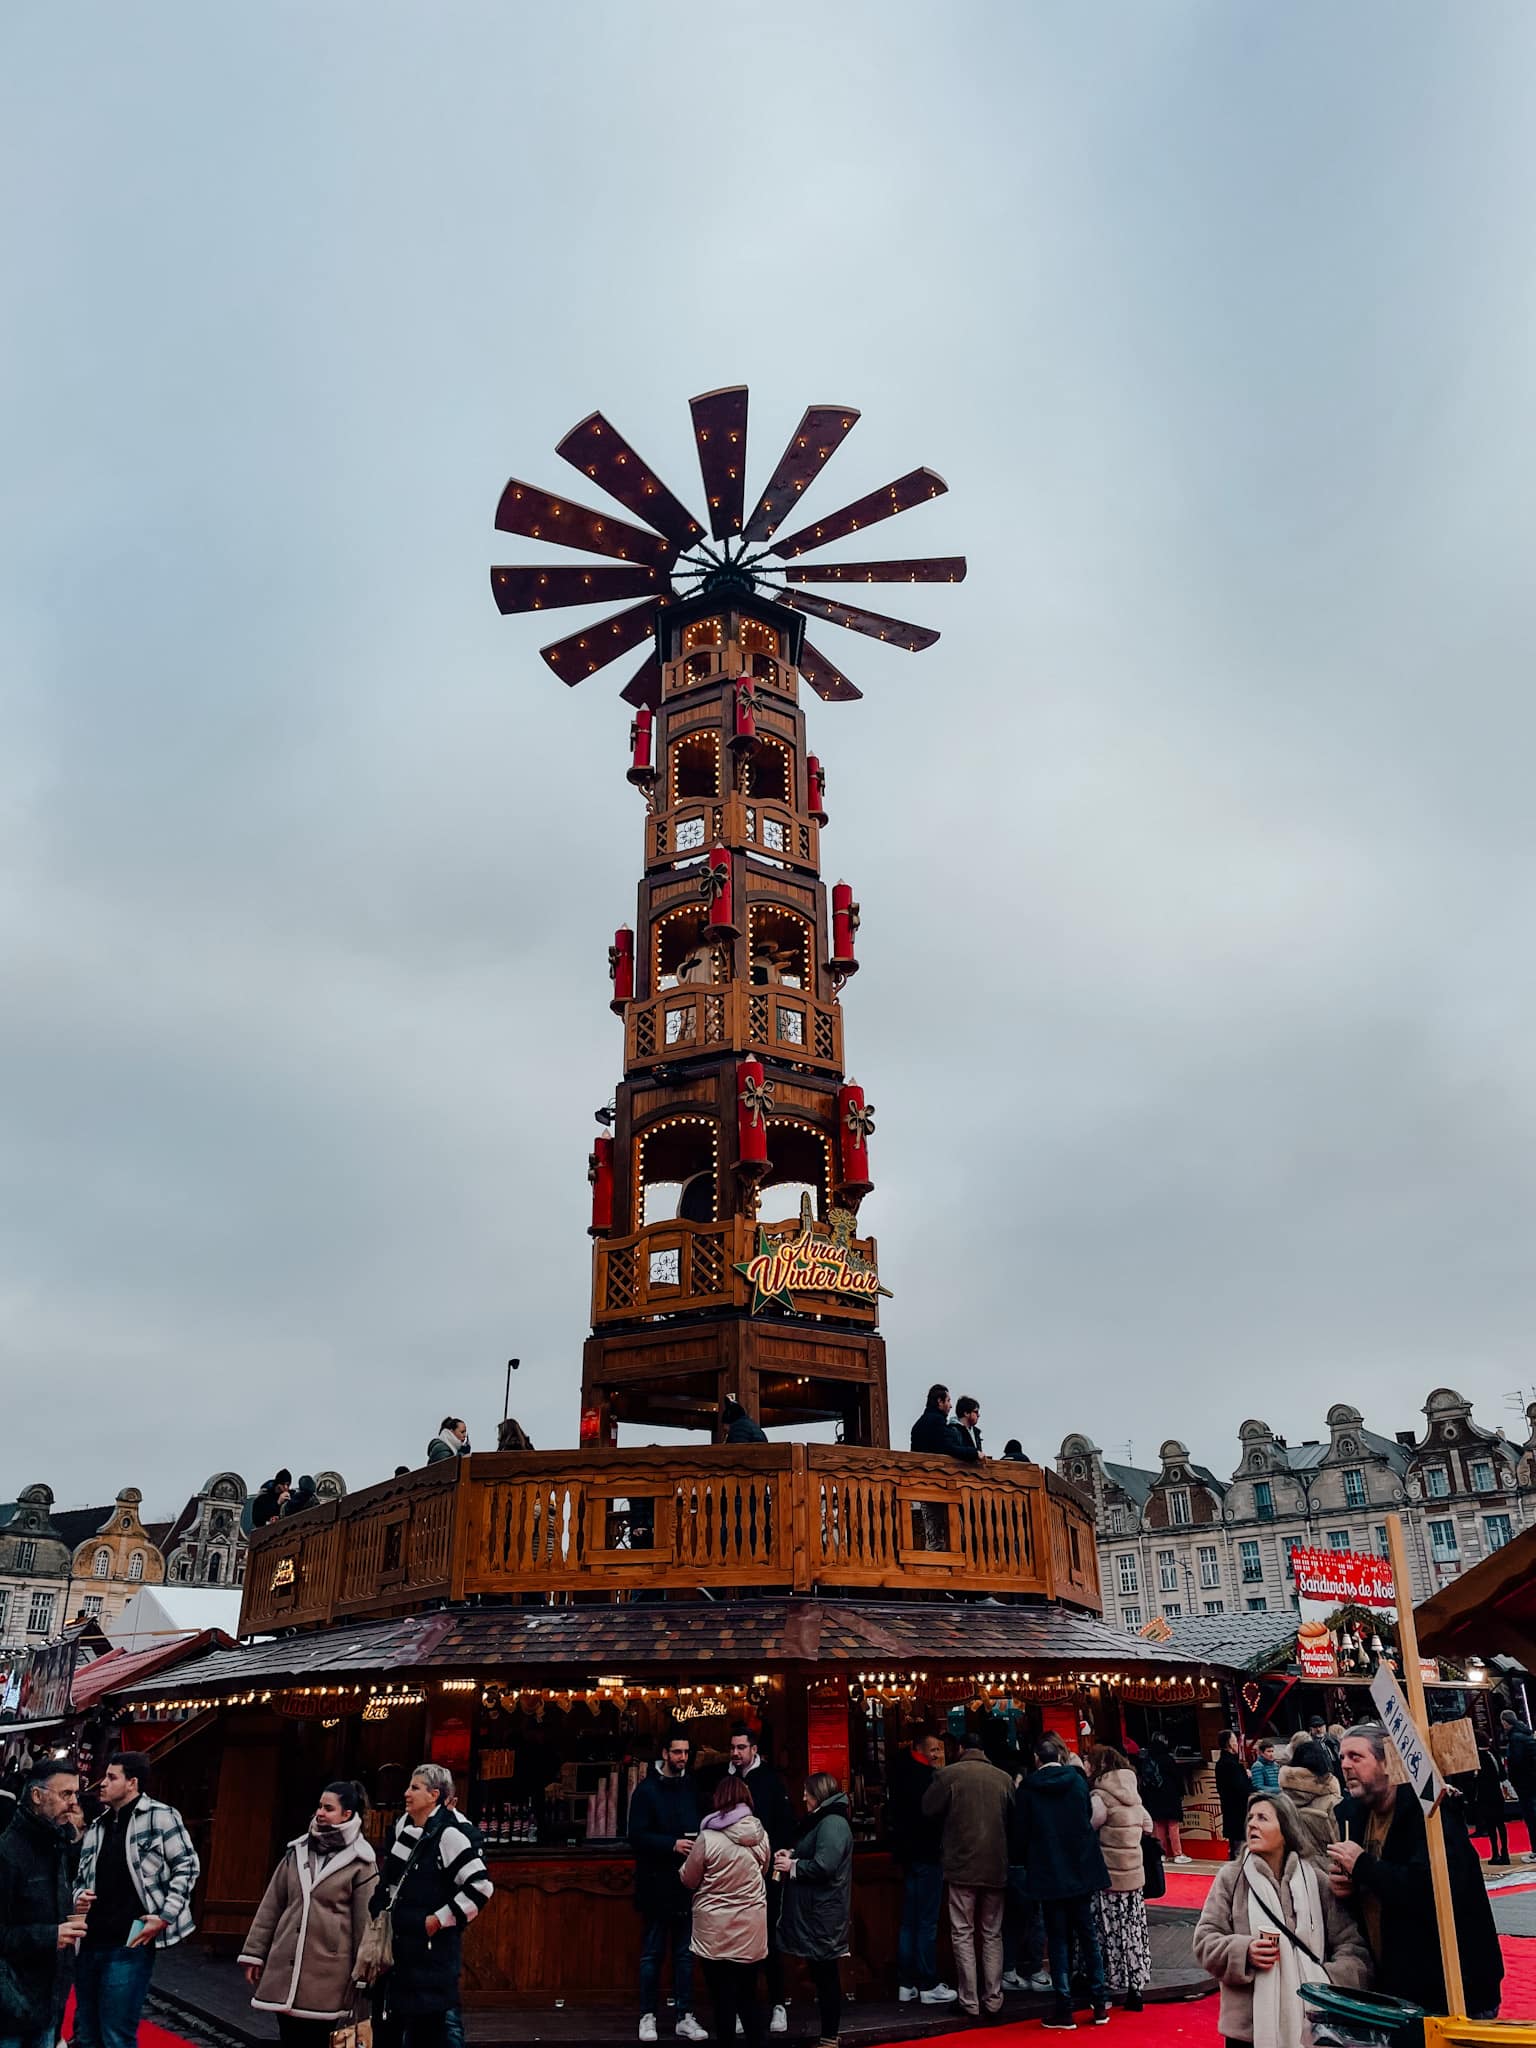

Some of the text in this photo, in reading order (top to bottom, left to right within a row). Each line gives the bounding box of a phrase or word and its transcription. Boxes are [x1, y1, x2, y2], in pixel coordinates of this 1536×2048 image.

[793, 1231, 846, 1264] Arras
[749, 1244, 879, 1294] Winter bar
[1299, 1571, 1396, 1599] Sandwichs de Noël
